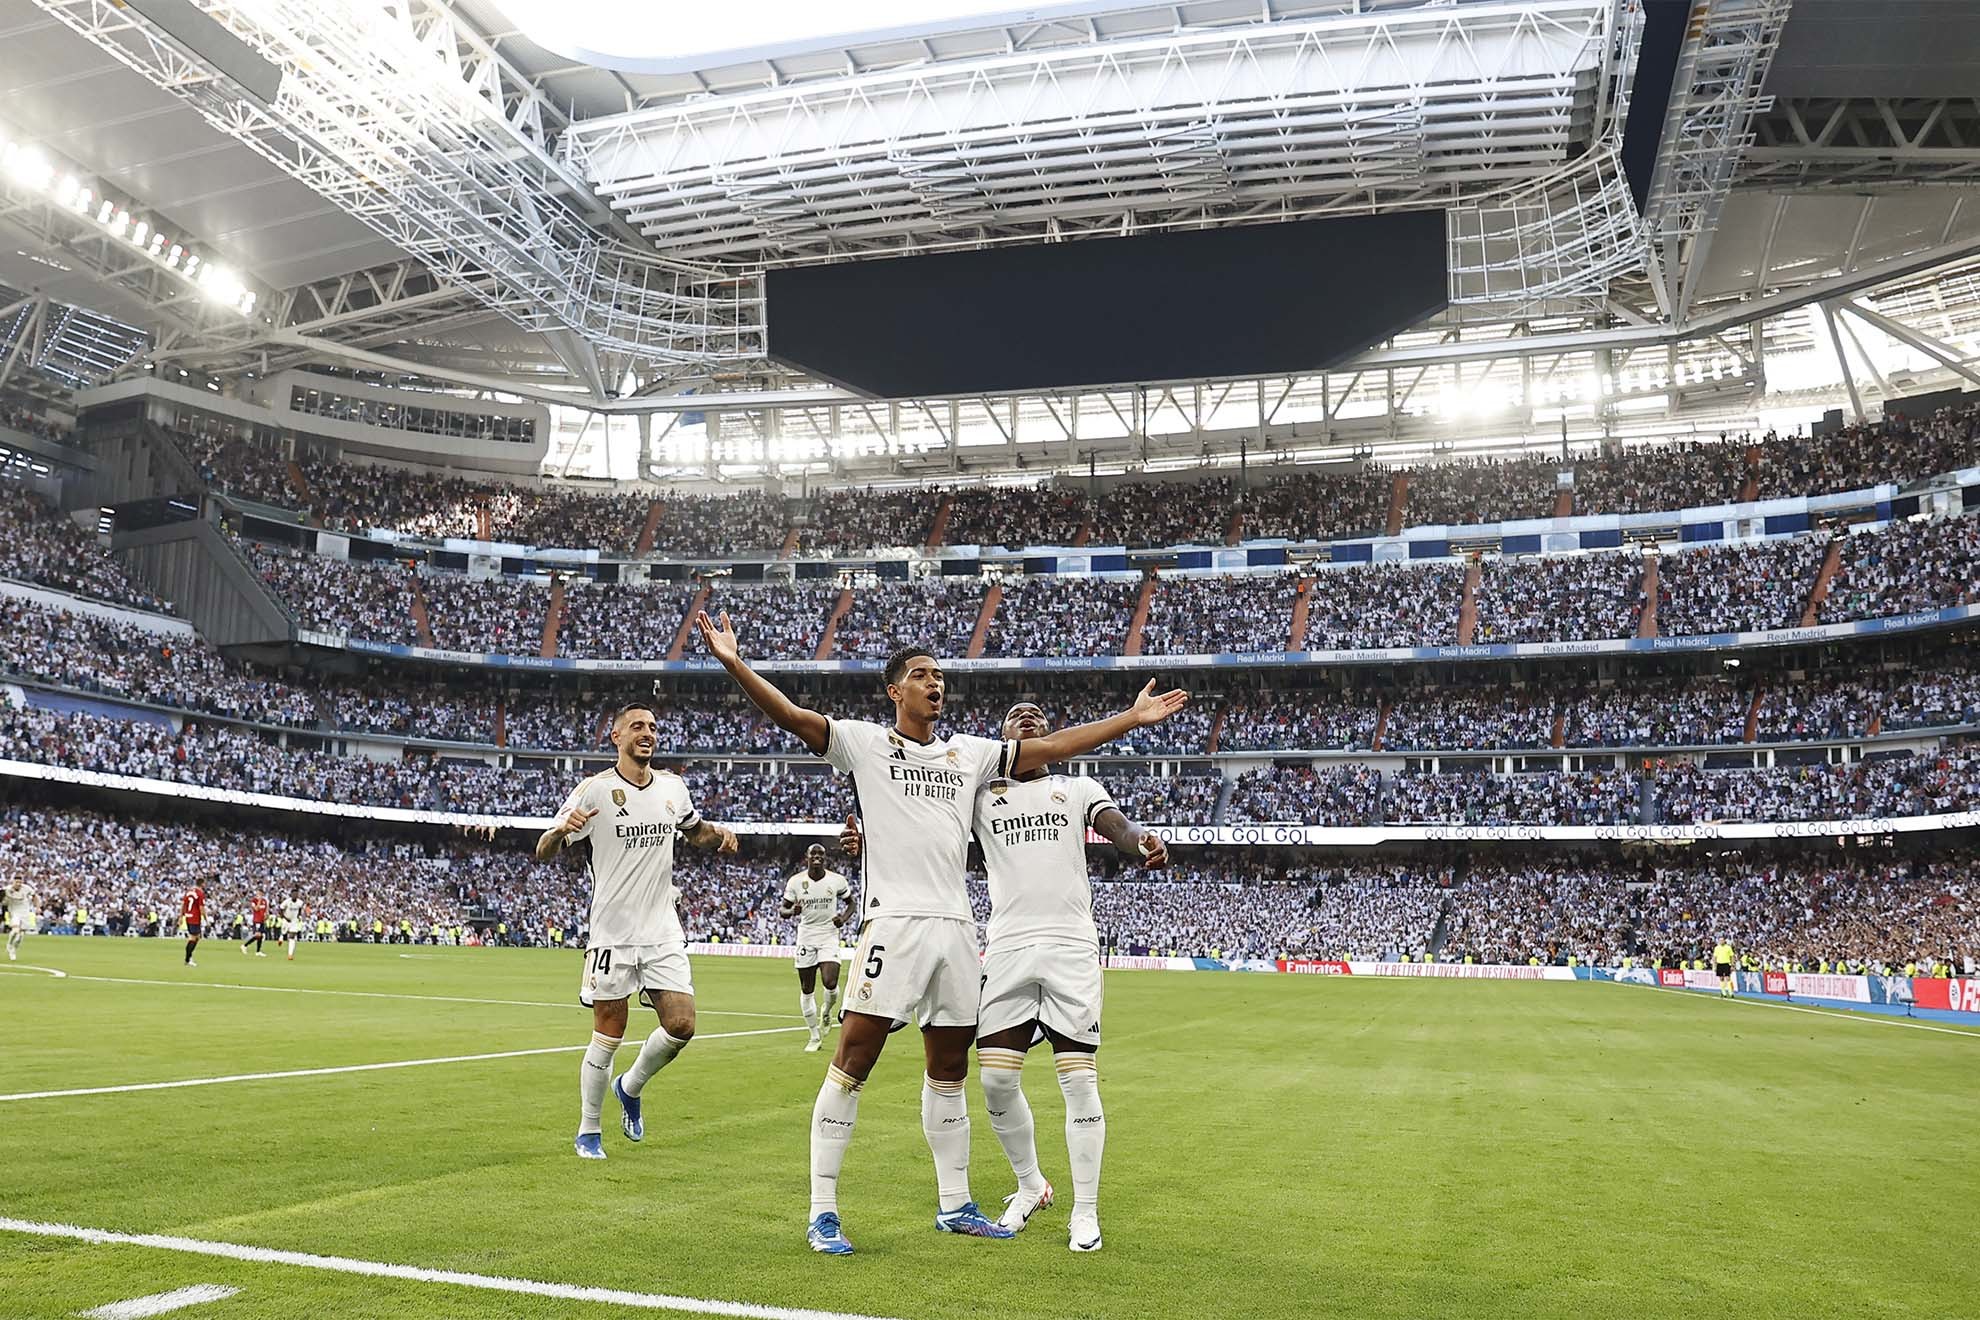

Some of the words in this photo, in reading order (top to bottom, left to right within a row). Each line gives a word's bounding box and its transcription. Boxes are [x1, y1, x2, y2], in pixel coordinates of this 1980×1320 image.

[1884, 619, 1906, 630] Real
[1907, 613, 1940, 625] Madrid
[1767, 632, 1789, 642] Real
[1792, 629, 1827, 639] Madrid
[1543, 645, 1563, 653] Real
[1566, 643, 1599, 652] Madrid
[1654, 640, 1674, 648] Real
[1677, 638, 1709, 647] Madrid
[1237, 655, 1255, 663] Real
[1257, 653, 1285, 662] Madrid
[1356, 651, 1387, 660] Madrid
[1439, 648, 1458, 657] Real
[1460, 647, 1490, 656] Madrid
[507, 657, 525, 665] Real
[526, 658, 553, 667] Madrid
[951, 661, 969, 669] Real
[970, 660, 998, 668] Madrid
[1045, 659, 1062, 667] Real
[1064, 658, 1091, 666] Madrid
[1158, 657, 1188, 665] Madrid
[889, 765, 963, 787] Emirates
[904, 783, 921, 796] FLY
[924, 785, 956, 800] BETTER
[991, 811, 1069, 834] Emirates
[616, 822, 673, 838] Emirates
[1188, 828, 1225, 842] GOL
[1232, 828, 1269, 842] GOL
[1275, 828, 1313, 843] GOL
[1425, 827, 1451, 838] GOL
[1455, 827, 1482, 838] GOL
[1487, 827, 1514, 838] GOL
[1518, 827, 1542, 838] GOL
[1595, 827, 1622, 838] GOL
[1627, 826, 1655, 838] GOL
[1660, 826, 1689, 837] GOL
[1693, 825, 1719, 837] GOL
[625, 838, 638, 849] FLY
[1006, 832, 1021, 847] FLY
[1024, 829, 1059, 842] BETTER
[592, 949, 611, 975] 14
[865, 945, 885, 978] 5
[1110, 957, 1168, 969] DESTINATIONS
[1286, 962, 1342, 975] Emirates
[1375, 964, 1389, 976] FLY
[1391, 964, 1421, 976] BETTER
[1424, 965, 1435, 977] TO
[1438, 966, 1460, 978] OVER
[1481, 966, 1545, 979] DESTINATIONS
